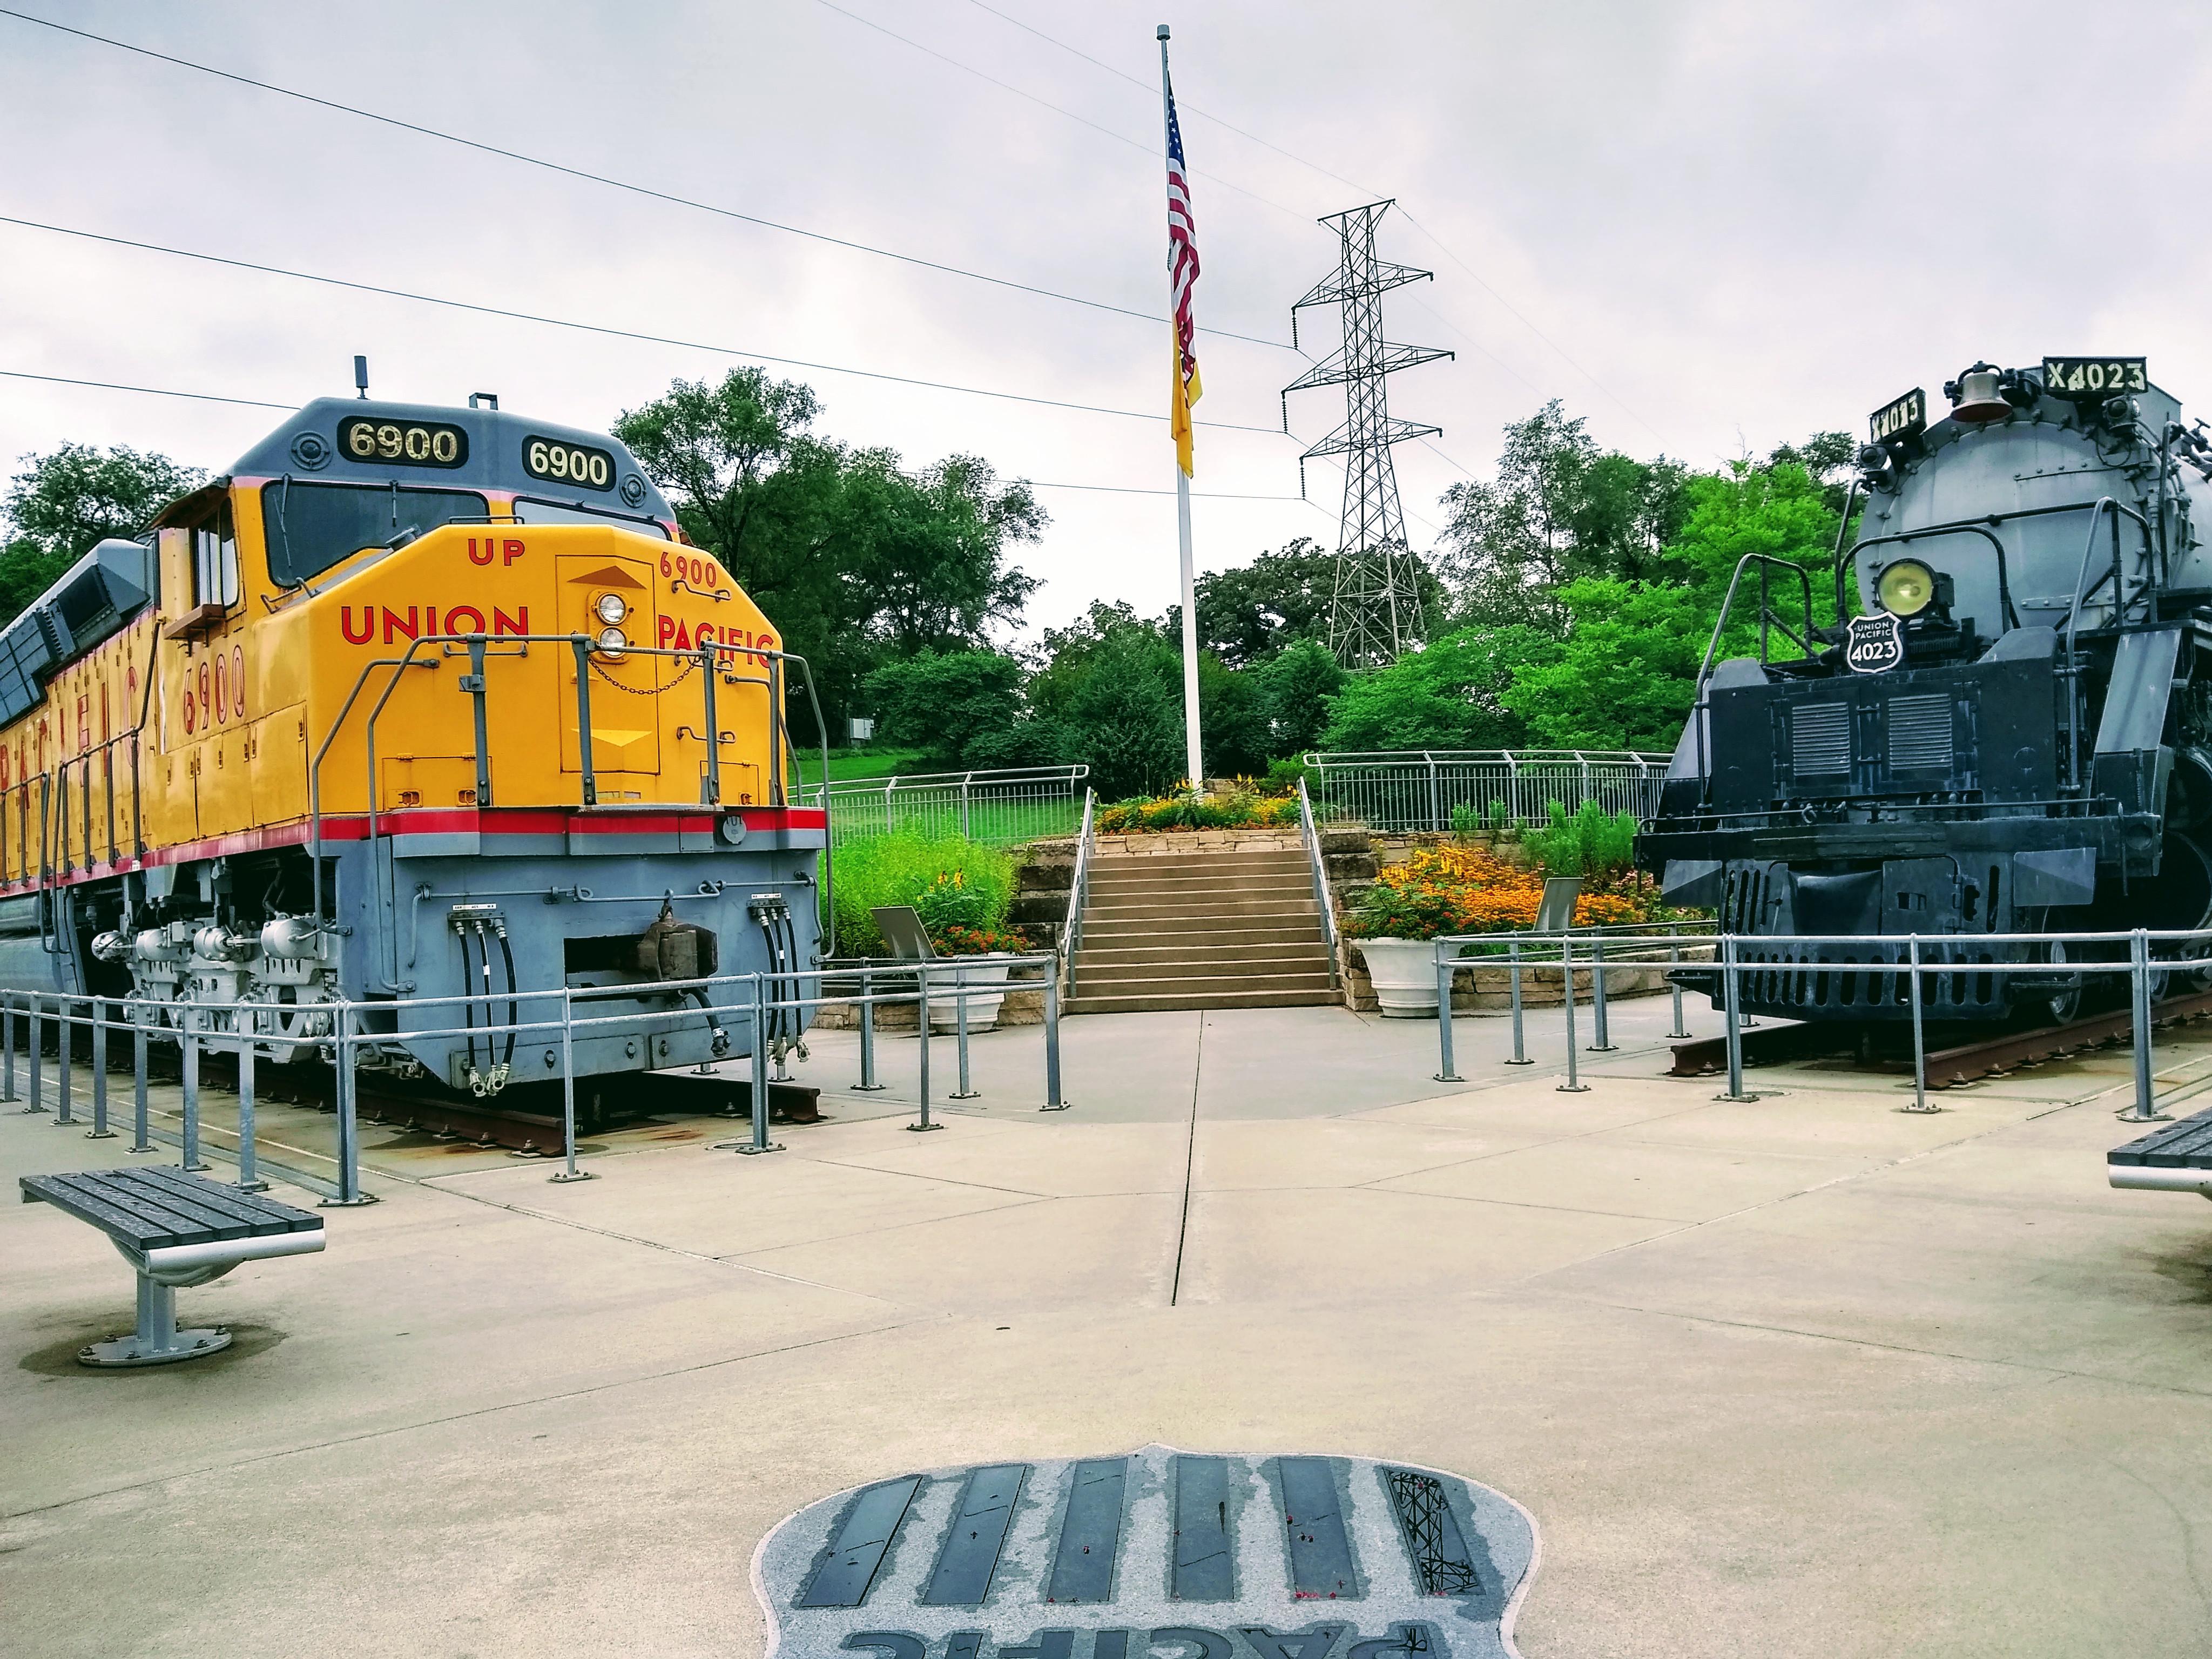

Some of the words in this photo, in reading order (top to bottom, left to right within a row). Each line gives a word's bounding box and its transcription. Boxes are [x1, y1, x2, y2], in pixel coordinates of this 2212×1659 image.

[2048, 362, 2145, 391] X4023
[349, 422, 458, 463] 6900
[529, 441, 608, 485] 6900
[468, 538, 525, 567] UP
[660, 551, 717, 588] 6900
[341, 605, 529, 646] UNION
[658, 614, 774, 669] PACIFIC
[1855, 629, 1891, 639] PACIFIC
[1857, 622, 1889, 632] UNION
[1851, 640, 1896, 662] 4023
[184, 644, 245, 735] 6900
